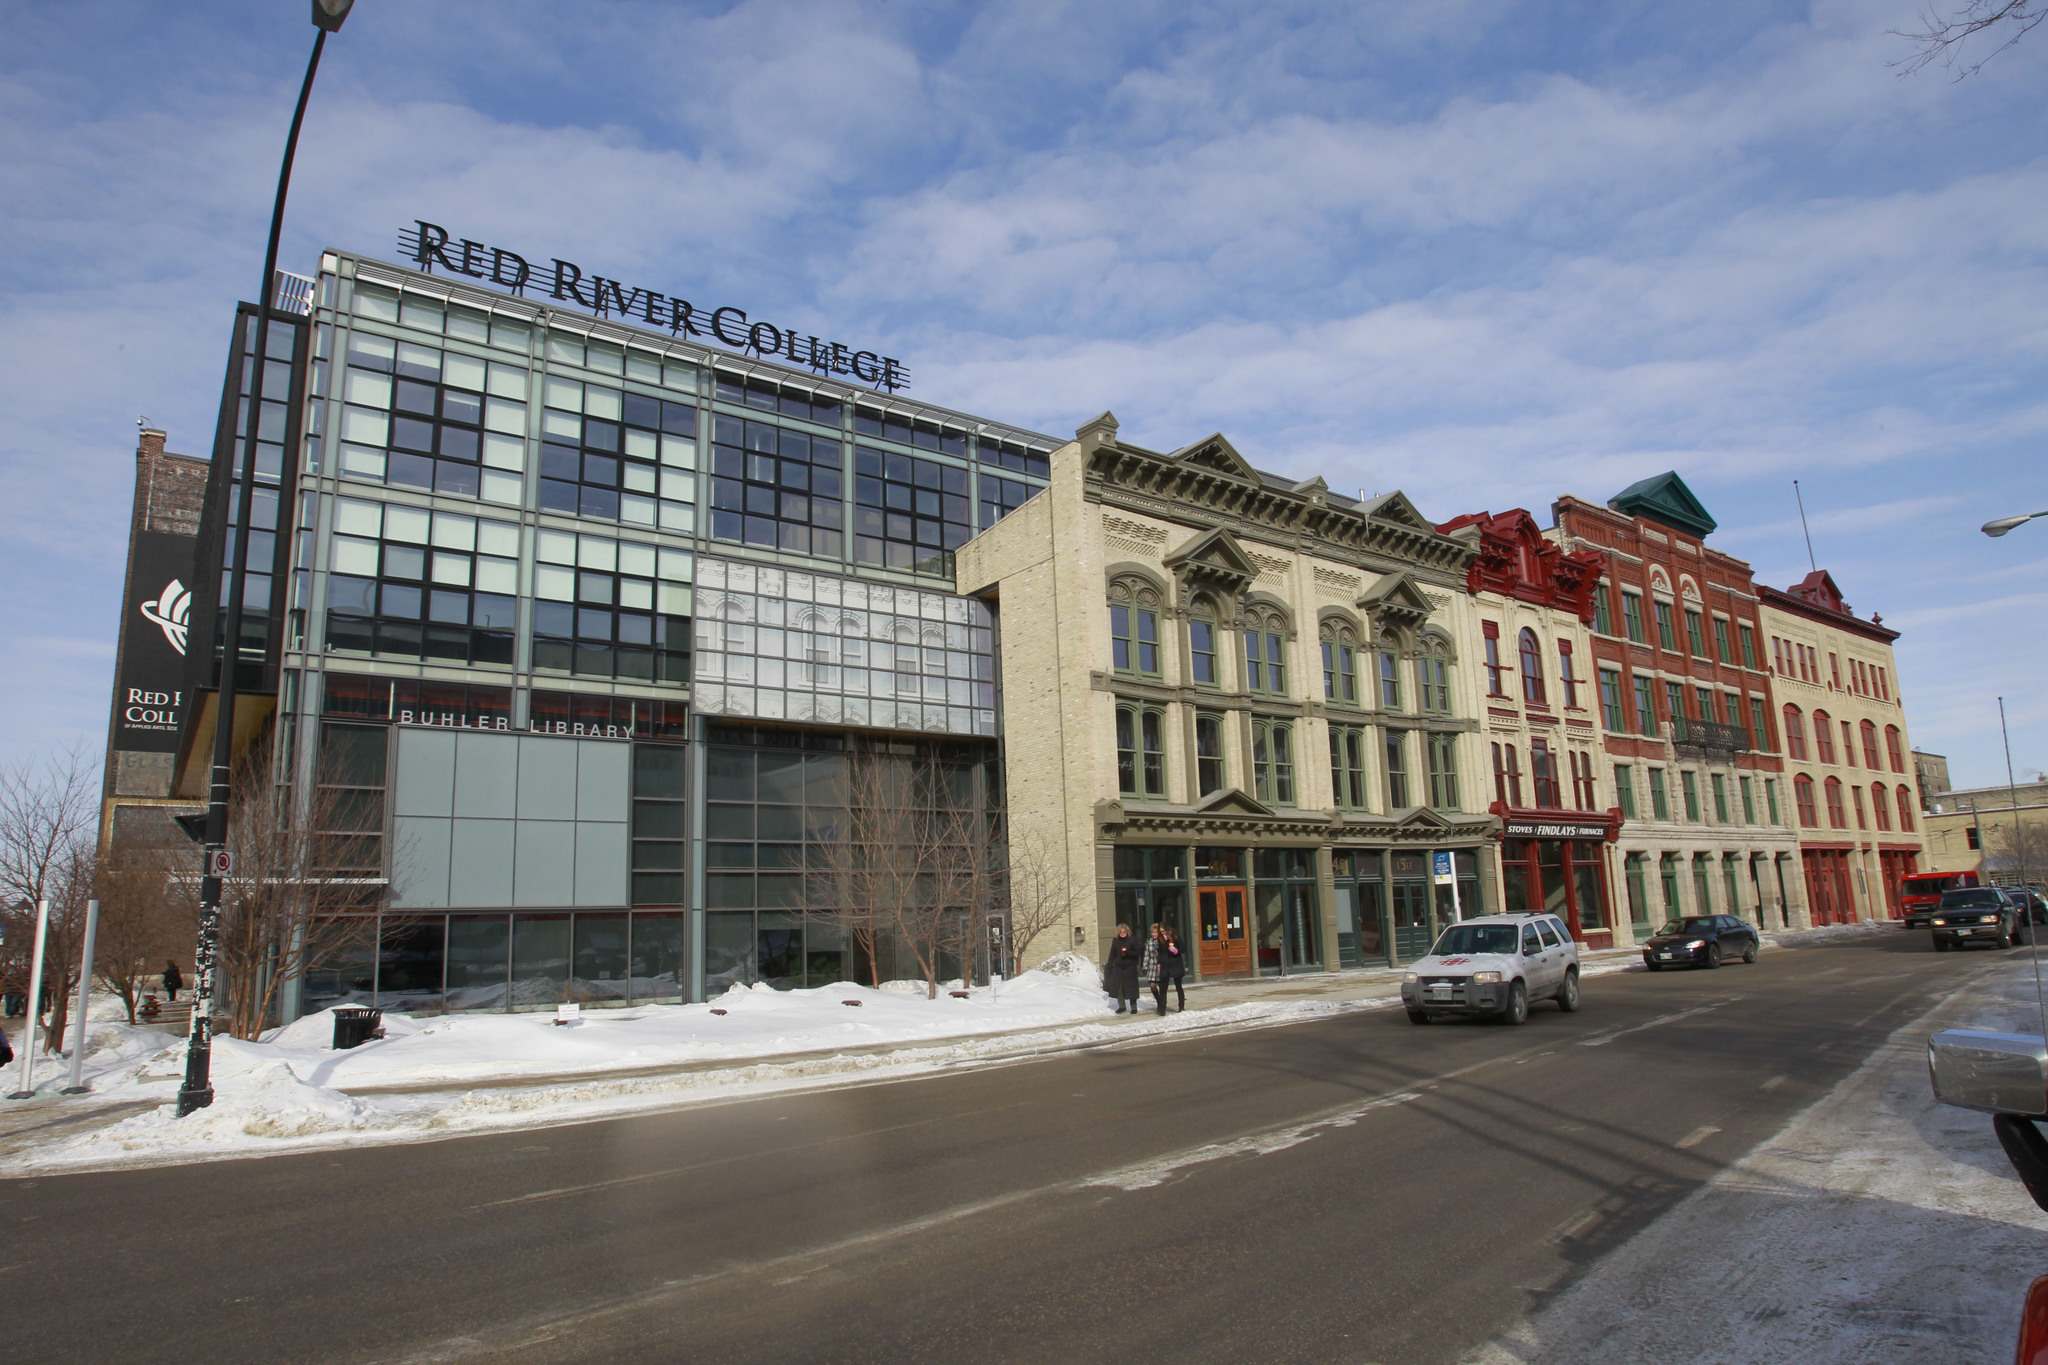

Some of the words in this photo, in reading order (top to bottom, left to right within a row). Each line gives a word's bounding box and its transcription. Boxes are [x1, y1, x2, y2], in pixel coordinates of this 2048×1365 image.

[413, 219, 530, 288] RED
[550, 257, 702, 337] RIVER
[711, 306, 902, 391] COLLEGE
[127, 687, 169, 705] RED
[401, 710, 509, 731] BUHLER
[530, 719, 633, 739] LIBRARY
[1507, 825, 1533, 834] STOVES
[1537, 825, 1577, 836] FINDLAYS
[1579, 827, 1604, 836] FURNACES
